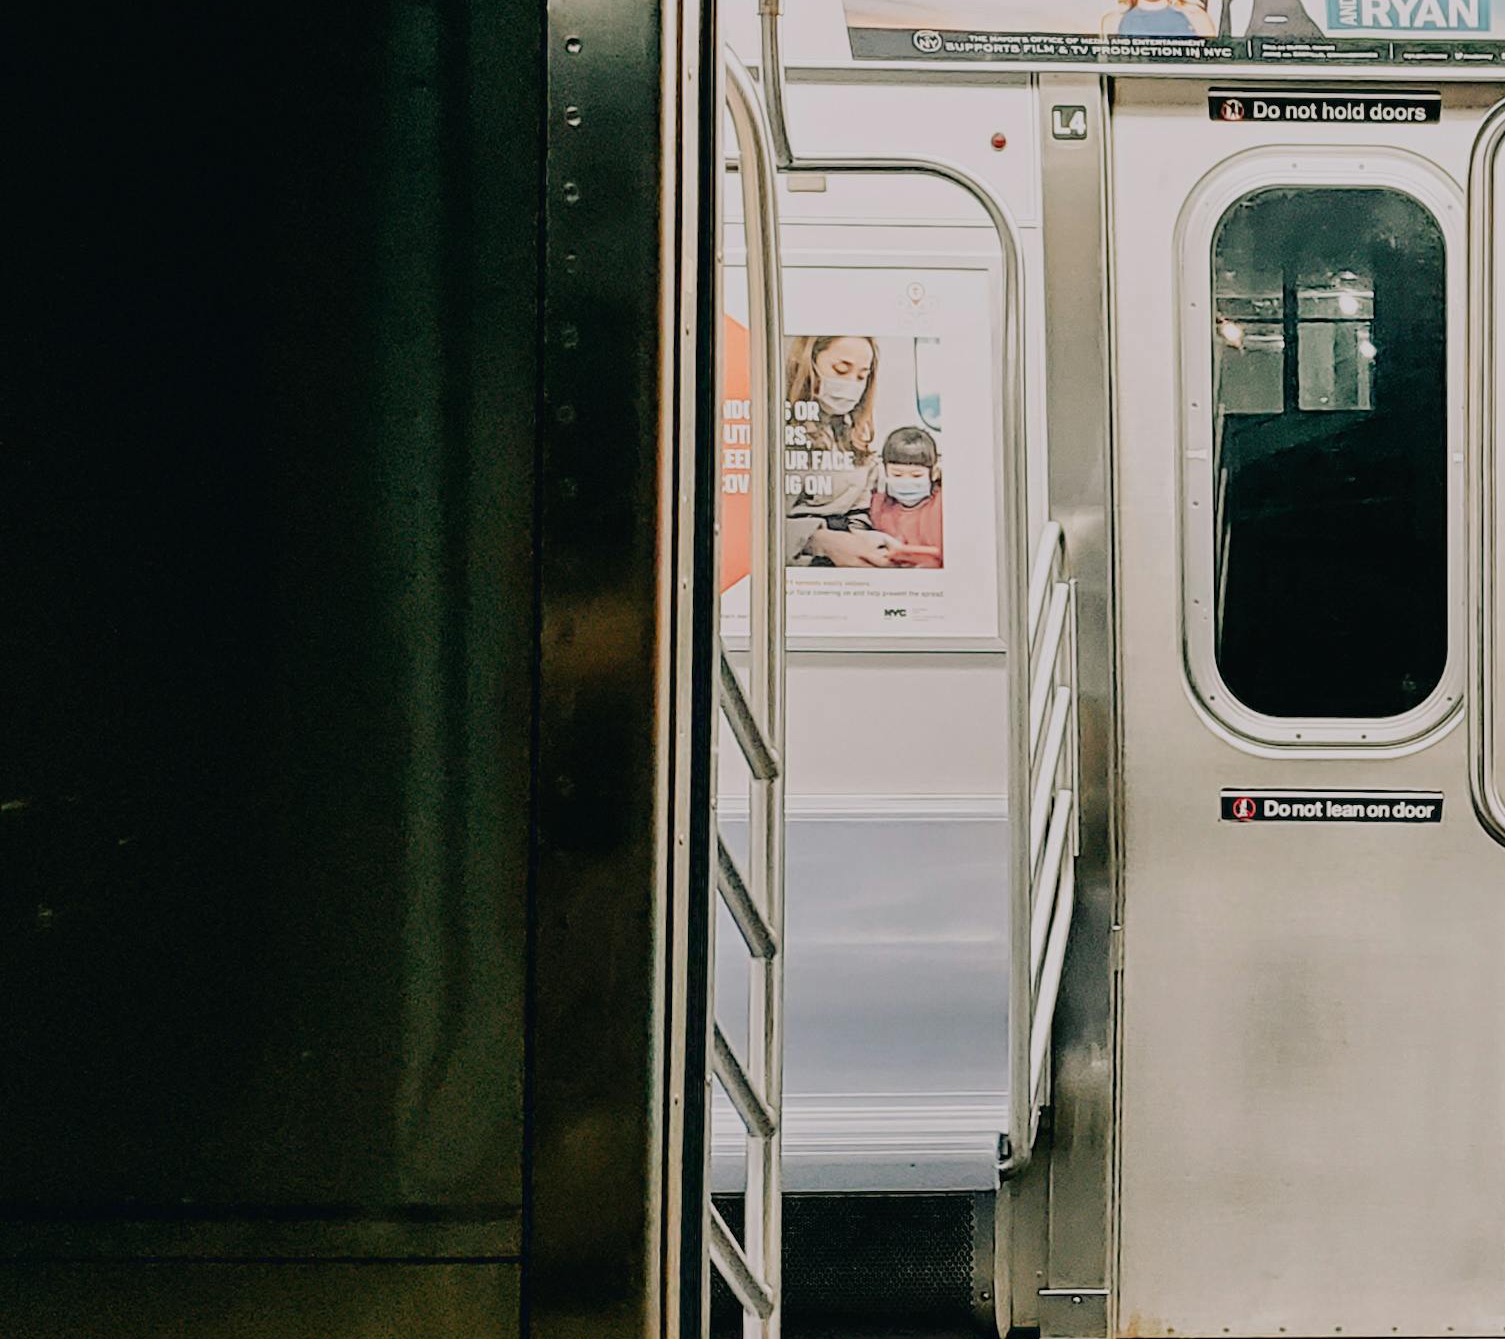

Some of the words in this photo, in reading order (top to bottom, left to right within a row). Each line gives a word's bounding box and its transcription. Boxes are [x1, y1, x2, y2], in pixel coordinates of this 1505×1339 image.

[944, 42, 1021, 54] SUPPORTS
[1023, 44, 1055, 54] FILM
[1071, 45, 1089, 55] TV
[1092, 46, 1183, 57] PRODUCTION
[1185, 47, 1200, 58] IN
[1204, 47, 1233, 57] NYC
[1253, 100, 1281, 119] Do
[1285, 102, 1318, 120] not
[1322, 102, 1365, 120] hold
[1369, 102, 1427, 121] doors
[1053, 110, 1087, 135] L4
[793, 400, 820, 422] OR
[811, 450, 857, 470] FACE
[804, 475, 833, 496] ON
[1263, 800, 1291, 818] Do
[1291, 801, 1323, 818] not
[1326, 801, 1366, 818] lean
[1366, 803, 1390, 819] on
[1392, 802, 1435, 819] door
